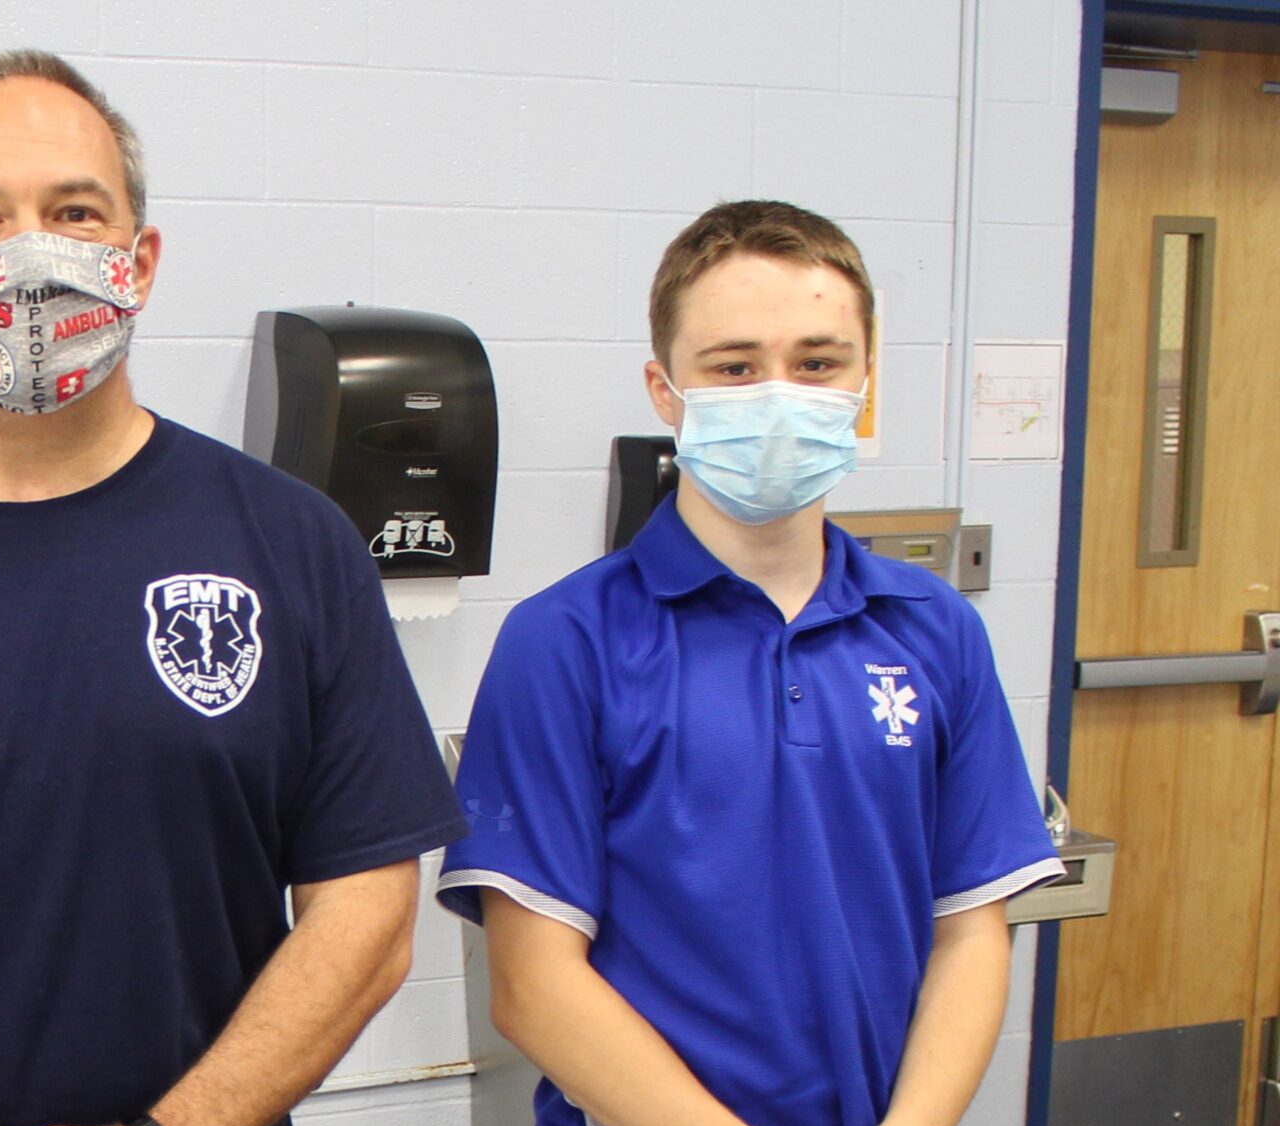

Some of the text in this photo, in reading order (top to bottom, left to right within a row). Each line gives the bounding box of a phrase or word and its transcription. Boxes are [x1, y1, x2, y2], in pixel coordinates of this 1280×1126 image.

[31, 232, 93, 260] SAVE A
[52, 259, 86, 285] LIFE
[29, 307, 46, 413] PROTECT
[164, 581, 245, 612] EMT
[163, 660, 192, 693] STATE
[225, 684, 239, 699] OF
[234, 643, 255, 687] HEALTH
[184, 671, 232, 691] CERTIFIED
[864, 663, 908, 675] Warren
[885, 734, 912, 747] EMS
